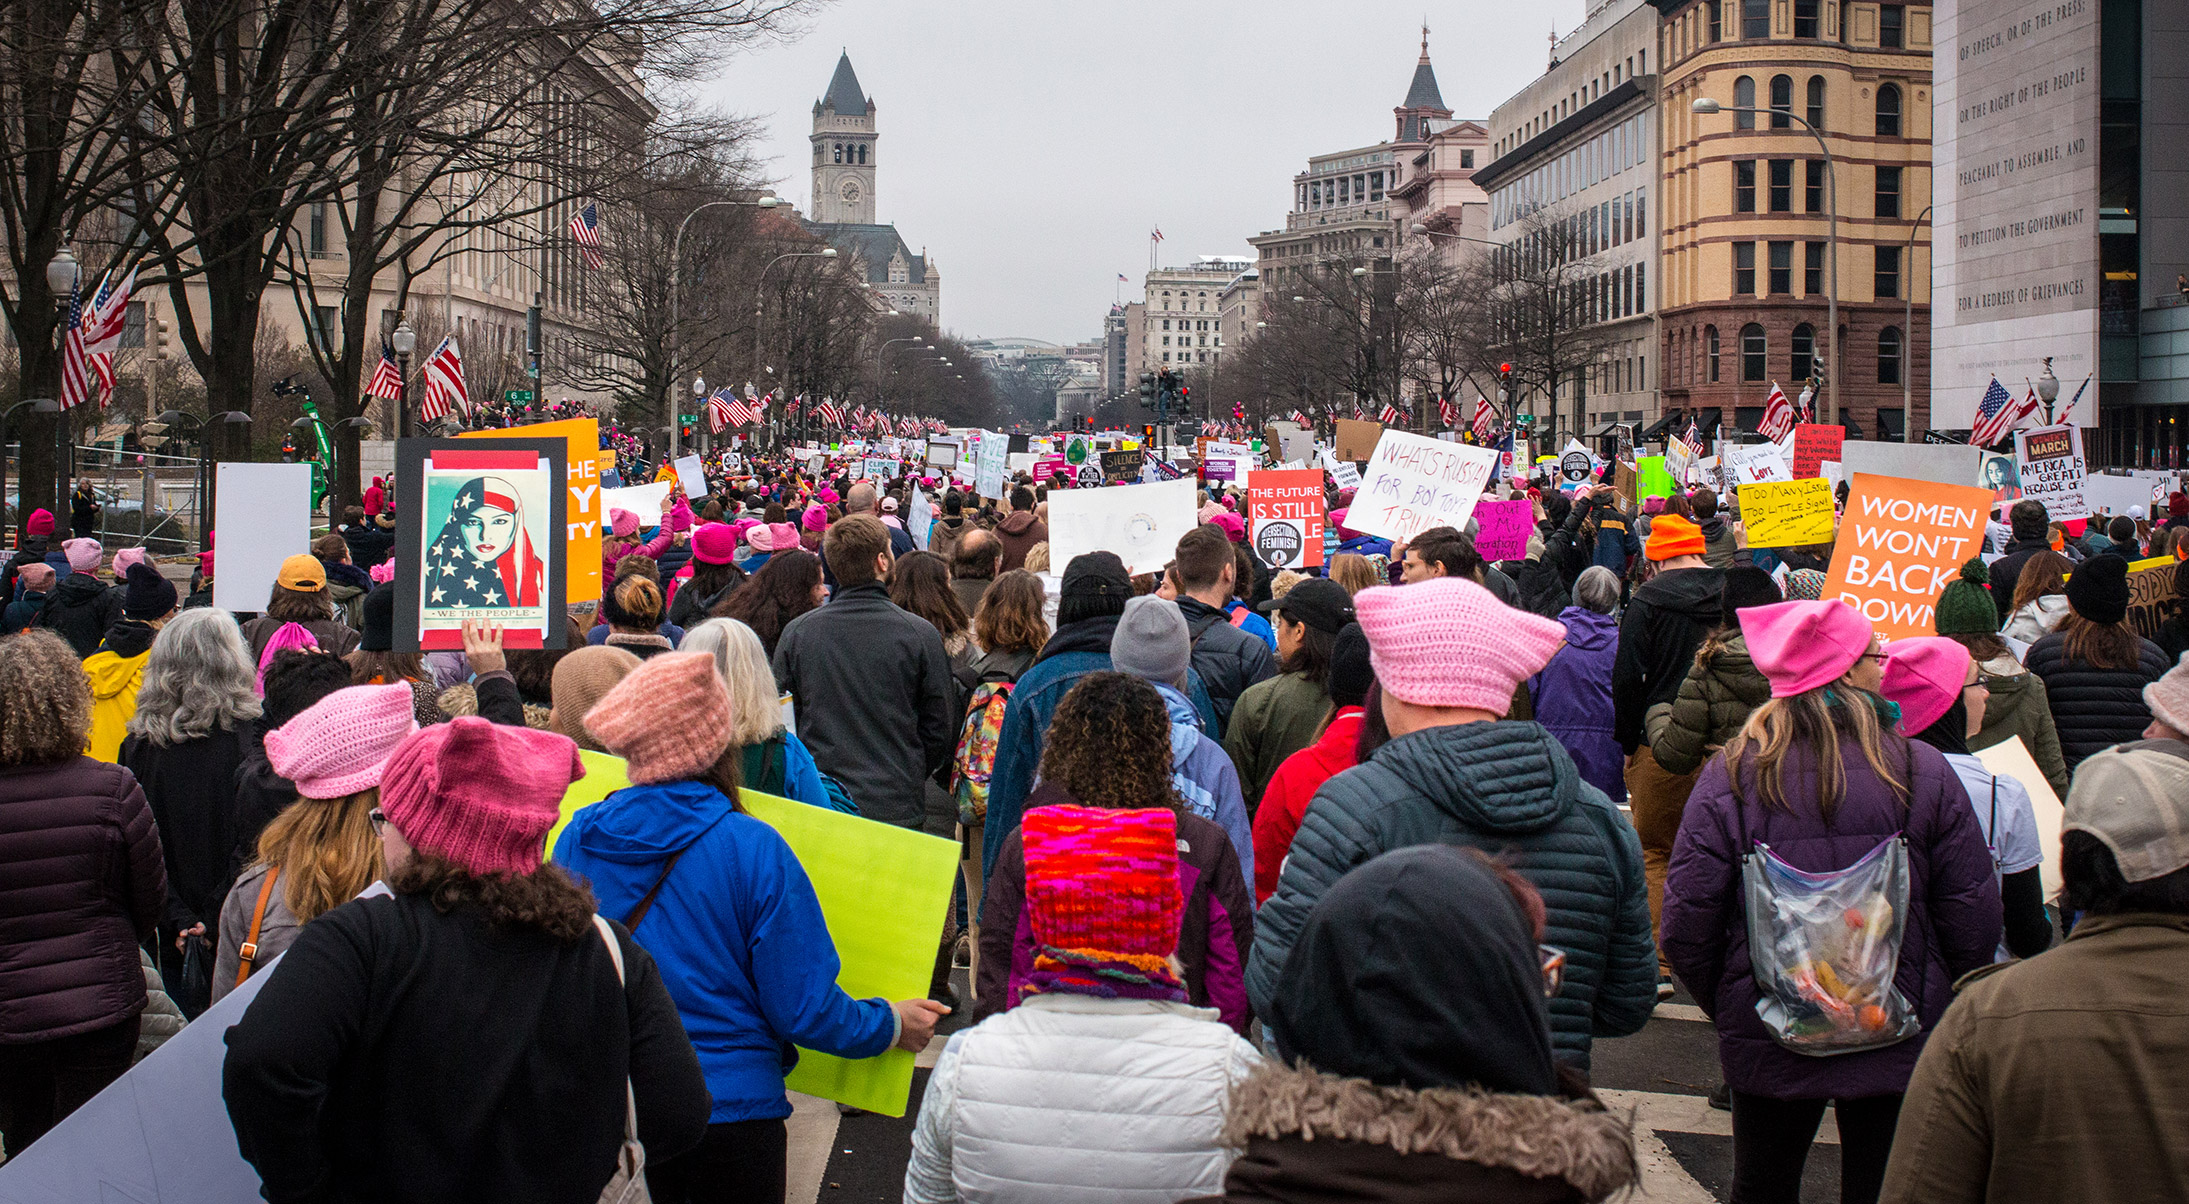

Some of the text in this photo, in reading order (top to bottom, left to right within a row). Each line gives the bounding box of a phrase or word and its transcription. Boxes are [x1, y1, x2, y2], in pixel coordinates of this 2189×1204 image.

[1960, 45, 1969, 61] OF
[1972, 31, 2004, 56] SPEECH,
[2007, 25, 2018, 41] OR
[2021, 19, 2031, 35] OF
[2035, 10, 2052, 30] THE
[1959, 67, 2085, 123] OR THE RIGHT OF THE PEOPLE
[1959, 138, 2085, 186] PEACEABLY TO ASSEMBLE, AND
[1959, 208, 2084, 249] TO PETITION THE GOVERNMENT
[1958, 278, 2084, 311] FOR A REDRESS OF GRIEVANCES
[511, 391, 518, 399] 6
[2030, 440, 2069, 456] MARCH
[567, 460, 596, 480] HE
[1106, 454, 1140, 468] SILENCE
[2021, 456, 2084, 476] AMERICA IS
[2039, 469, 2081, 482] GREAT!
[1250, 486, 1321, 498] THE FUTURE
[1372, 473, 1402, 500] FOR
[1410, 484, 1439, 507] BOY
[1440, 492, 1468, 515] TOY?
[2024, 481, 2065, 495] BECAUSE
[1252, 501, 1321, 519] IS STILL
[1495, 502, 1520, 516] Out
[1861, 495, 1977, 529] WOMEN
[1495, 517, 1521, 535] My
[1261, 538, 1298, 549] FEMINISM
[1474, 536, 1519, 551] neration
[1855, 524, 1969, 560] WON'T
[1844, 555, 1957, 596] BACK
[2125, 566, 2175, 606] BODY
[486, 609, 530, 617] PEOPLE
[1839, 592, 1935, 627] DOWN
